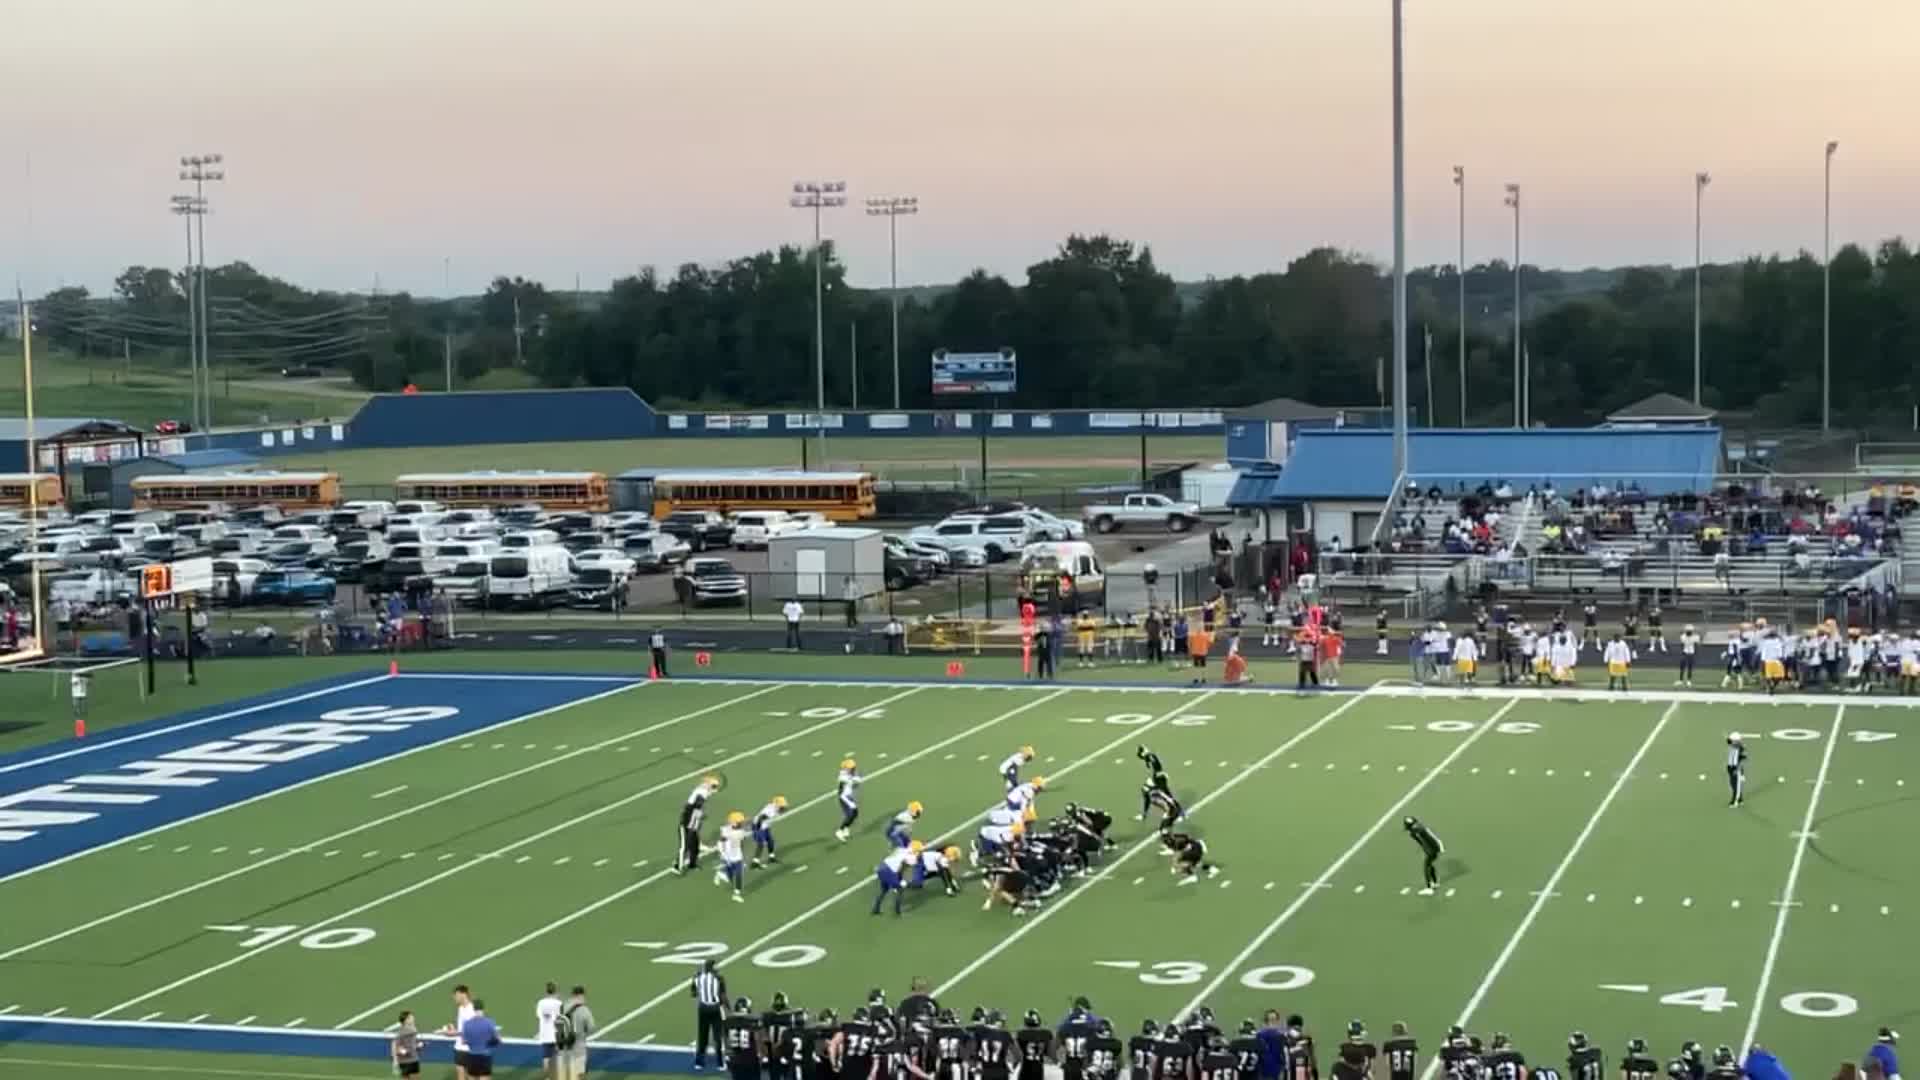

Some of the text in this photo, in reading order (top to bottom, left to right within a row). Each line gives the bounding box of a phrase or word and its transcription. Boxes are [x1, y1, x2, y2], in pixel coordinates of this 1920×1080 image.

[239, 924, 376, 949] 10
[650, 942, 828, 968] 20
[1138, 961, 1315, 990] 30
[1660, 986, 1859, 1017] 40
[791, 1037, 803, 1060] 2
